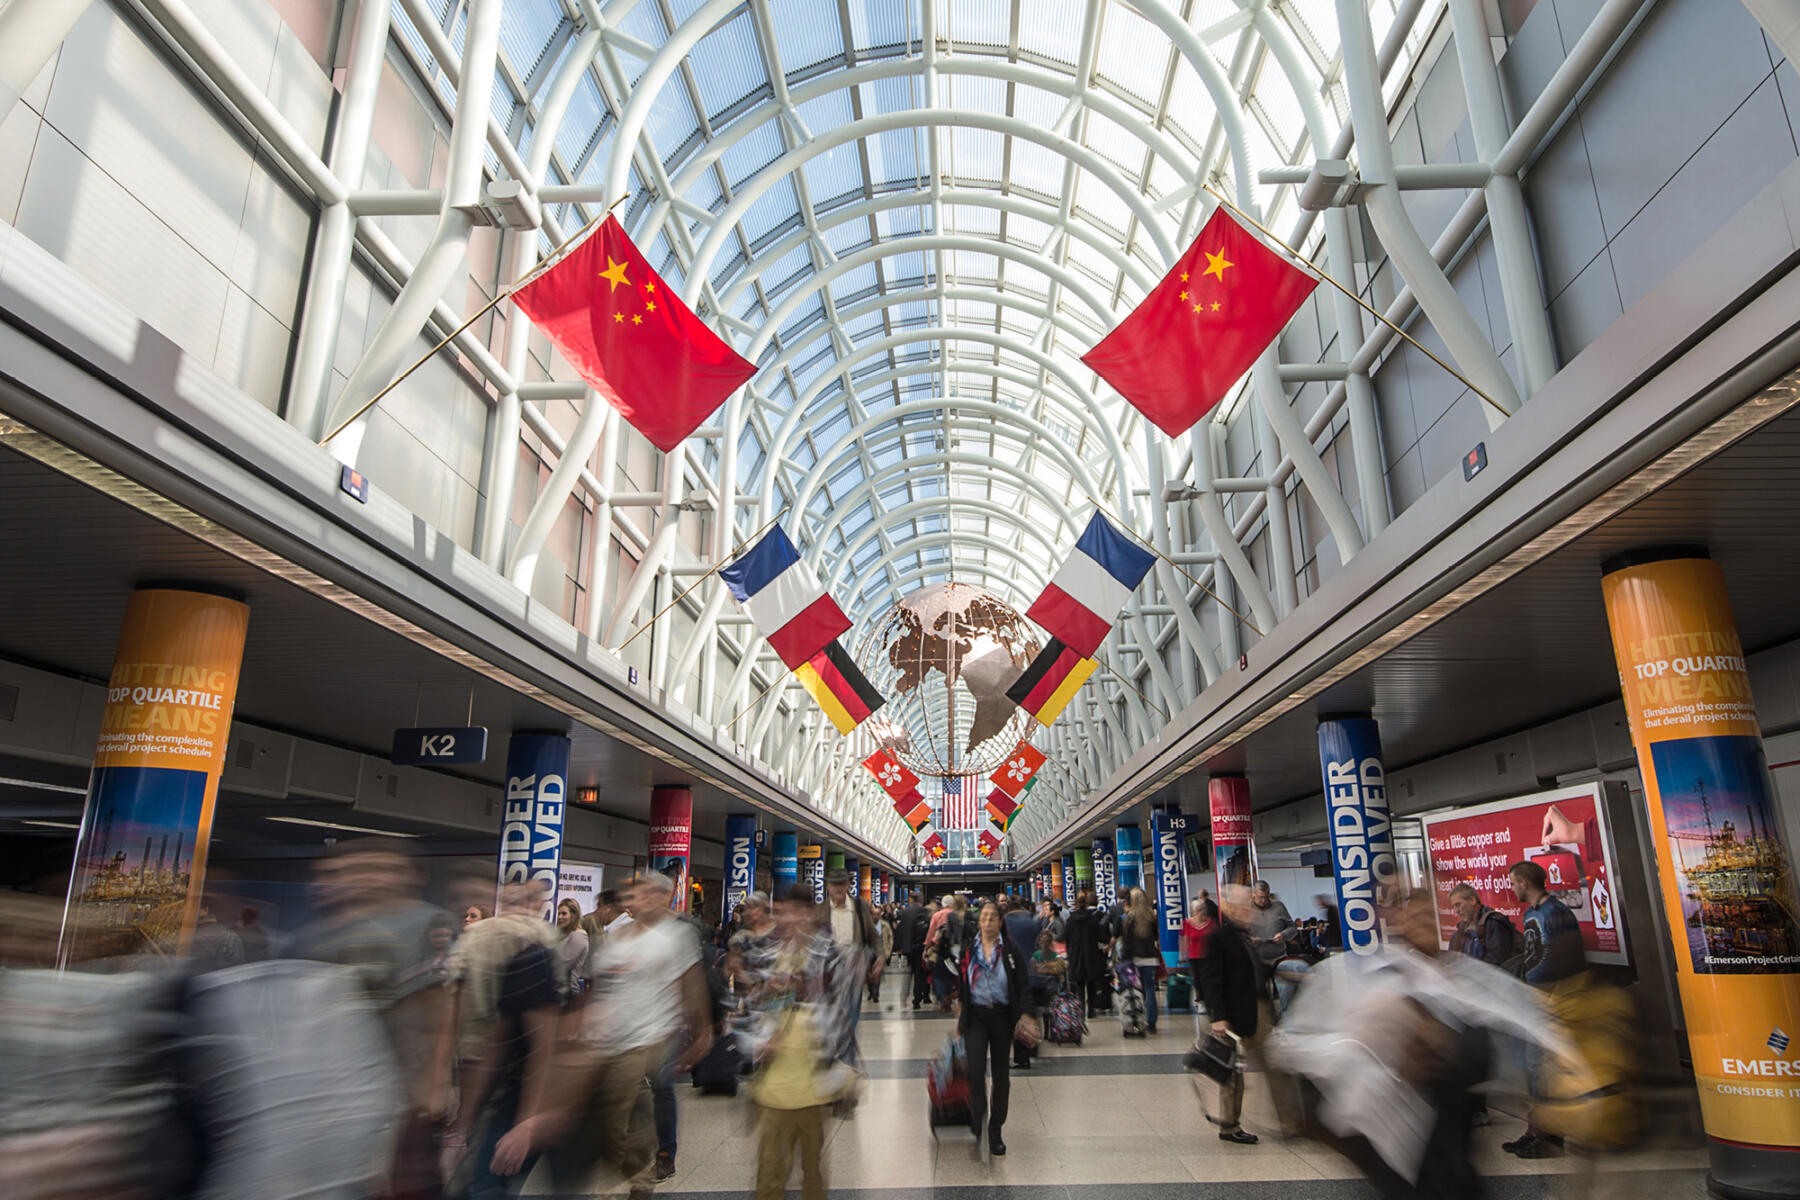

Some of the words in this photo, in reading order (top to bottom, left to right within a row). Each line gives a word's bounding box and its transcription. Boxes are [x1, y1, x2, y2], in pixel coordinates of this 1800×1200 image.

[1634, 660, 1668, 679] TOP
[132, 686, 222, 710] QUARTILE
[103, 703, 218, 735] MEANS
[1643, 704, 1695, 719] Eliminating
[1696, 702, 1714, 711] the
[1645, 719, 1662, 728] that
[1663, 713, 1692, 725] derail
[1694, 711, 1729, 724] project
[106, 743, 129, 752] derail
[129, 744, 166, 754] project
[137, 731, 155, 742] the
[155, 734, 213, 749] complexities
[420, 734, 456, 756] K2
[1170, 818, 1186, 829] H3
[1360, 757, 1397, 907] SOLVED
[1430, 837, 1445, 851] Give
[1445, 839, 1451, 850] a
[1450, 834, 1466, 849] little
[1467, 833, 1493, 849] copper
[1495, 827, 1511, 843] and
[1328, 758, 1379, 956] CONSIDER
[1436, 858, 1454, 871] show
[1454, 856, 1467, 869] the
[1467, 853, 1488, 868] world
[1489, 854, 1508, 871] your
[815, 860, 825, 904] OLVED
[1065, 866, 1076, 912] MERSON
[1104, 853, 1117, 906] SOLVED
[1160, 831, 1183, 931] EMERSON
[1484, 875, 1493, 889] of
[1716, 1084, 1784, 1098] CONSIDER
